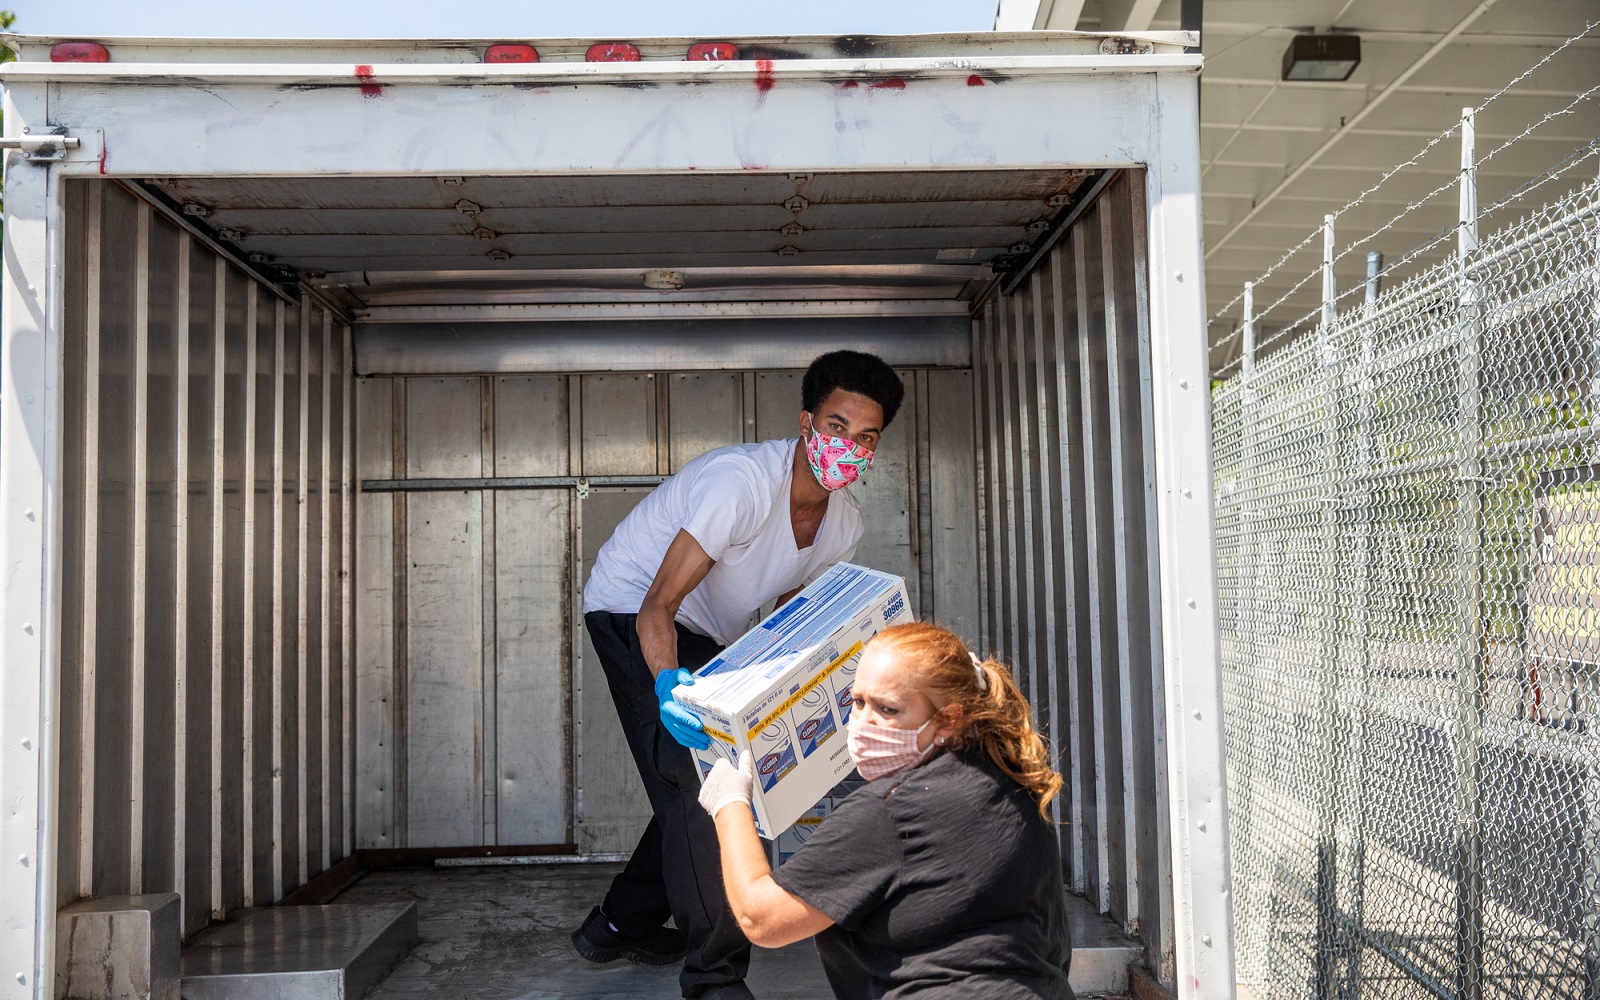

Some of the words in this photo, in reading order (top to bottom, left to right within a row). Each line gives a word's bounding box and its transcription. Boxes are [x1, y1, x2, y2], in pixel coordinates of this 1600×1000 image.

[882, 598, 904, 620] 30966
[746, 706, 762, 720] Botellas
[754, 724, 764, 734] Kills
[765, 711, 780, 724] 99.9%
